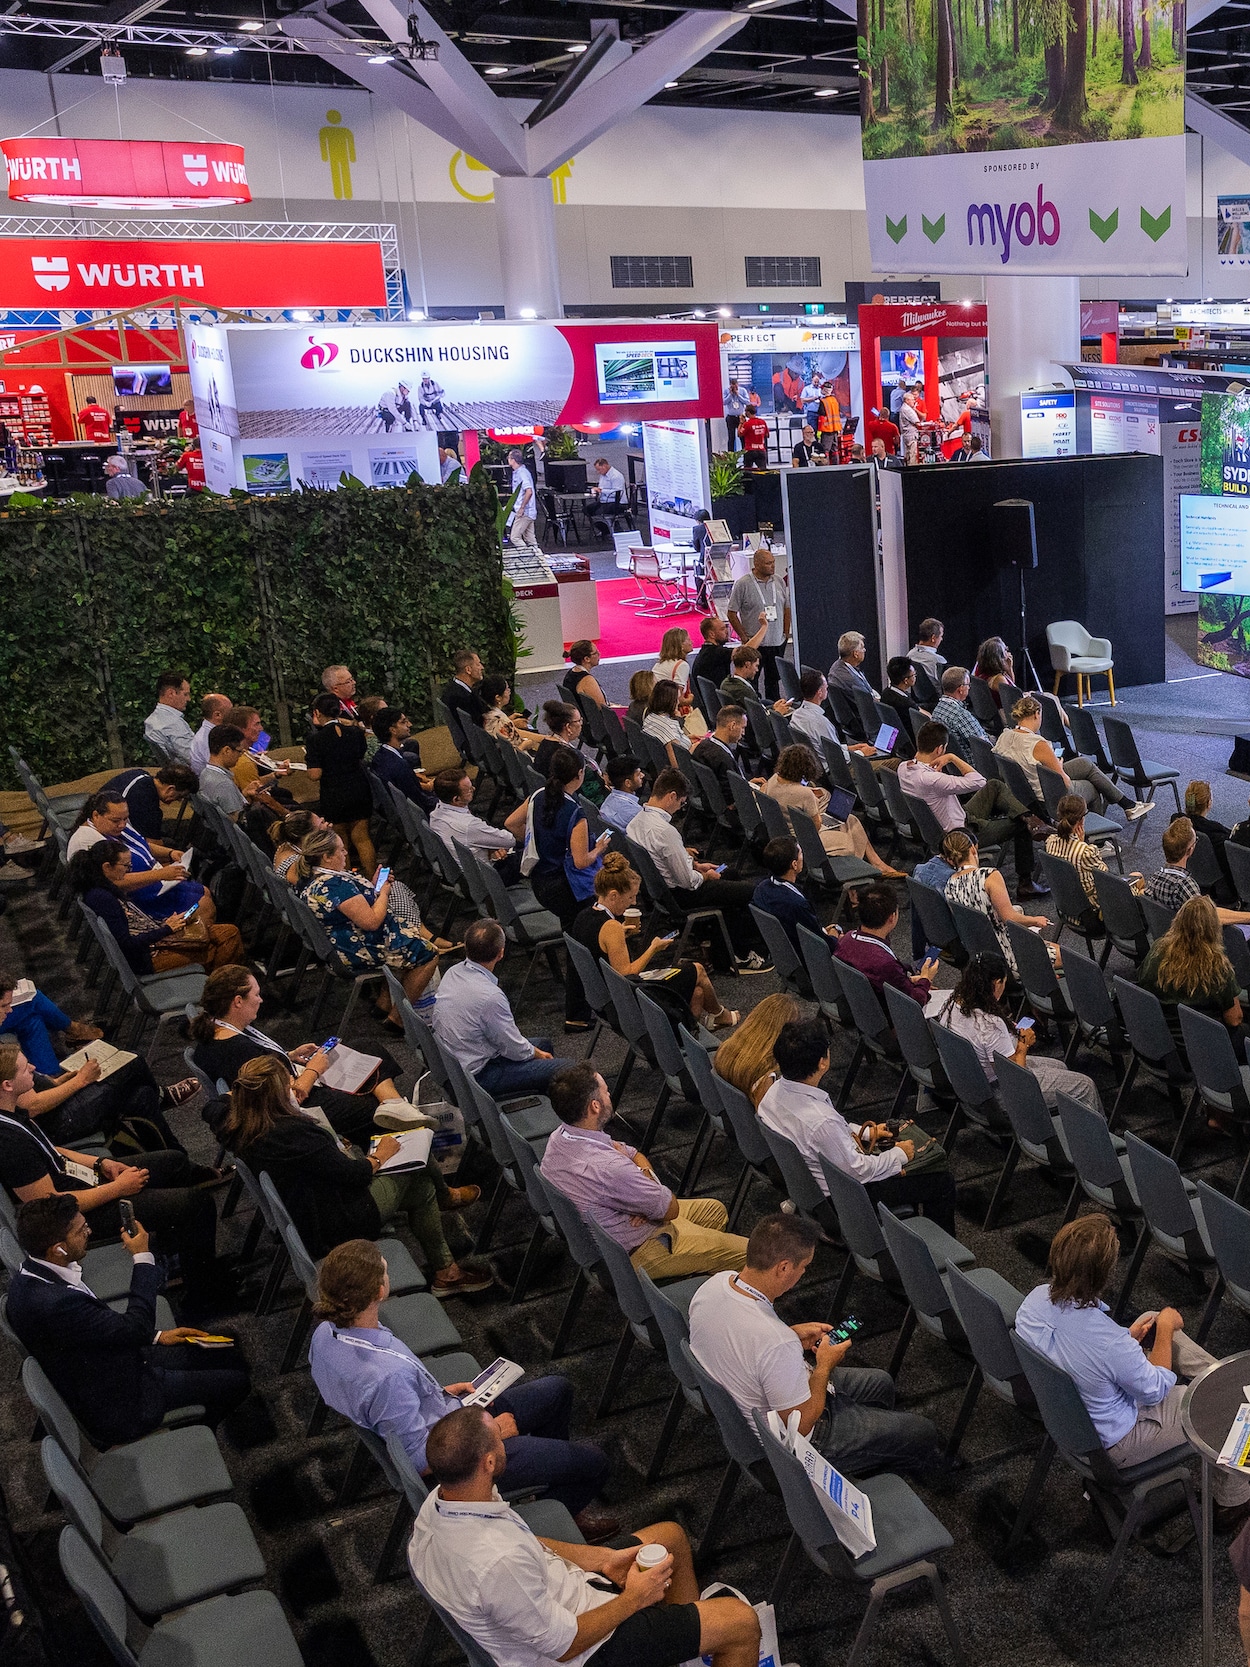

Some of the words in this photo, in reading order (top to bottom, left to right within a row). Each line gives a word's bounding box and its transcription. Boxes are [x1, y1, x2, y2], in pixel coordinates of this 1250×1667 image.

[8, 157, 82, 181] WÜRTH
[211, 160, 248, 186] WÜR
[983, 163, 1027, 173] SPONSORED
[1029, 162, 1040, 171] BY
[967, 184, 1061, 264] myob
[77, 264, 205, 288] WÜRTH
[900, 309, 947, 327] Milwaukee
[731, 333, 777, 343] PERFECT
[812, 332, 856, 341] PERFECT
[350, 347, 434, 363] DUCKSHIN
[439, 345, 509, 361] HOUSING
[1073, 366, 1137, 378] CONSTRUCTION
[1169, 373, 1205, 384] SUPPLY
[143, 418, 180, 431] WÜR
[1223, 482, 1248, 494] BUILD
